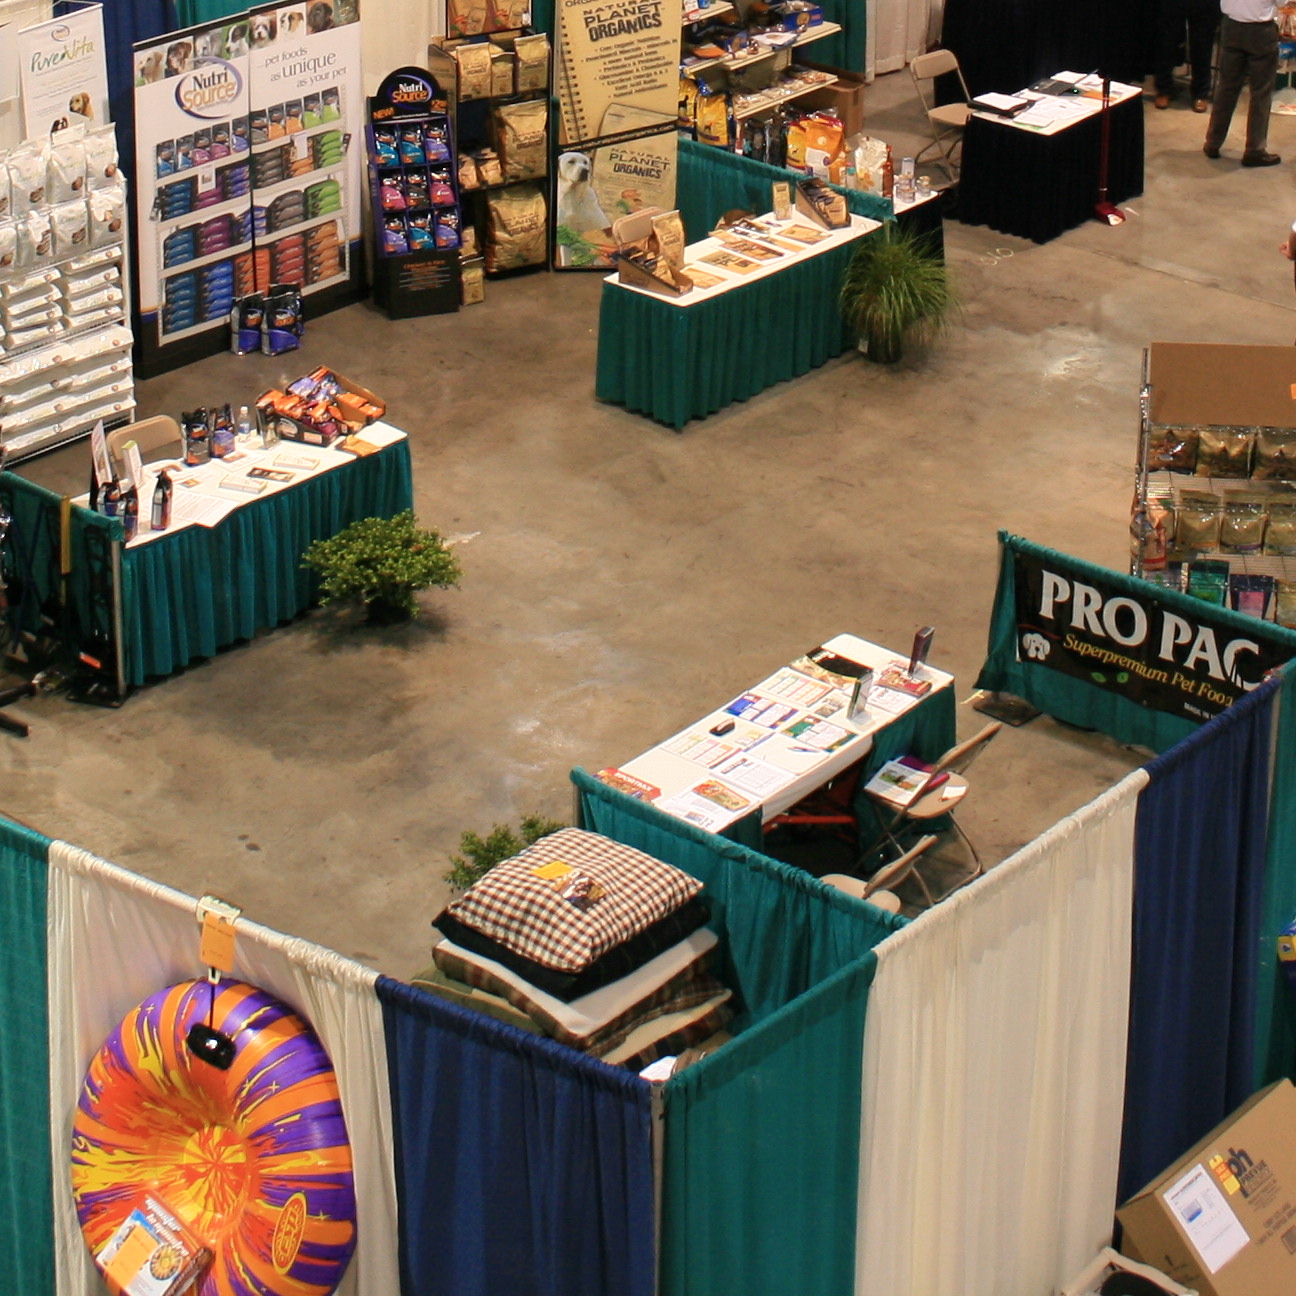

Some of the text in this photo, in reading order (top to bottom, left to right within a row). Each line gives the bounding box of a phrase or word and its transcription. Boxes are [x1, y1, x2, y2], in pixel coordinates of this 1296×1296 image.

[584, 1, 662, 28] PLANET
[589, 12, 662, 42] ORGANICS
[281, 48, 307, 61] foods
[270, 52, 337, 82] as unique
[296, 66, 347, 88] as your pet
[192, 67, 229, 91] Nutri
[398, 81, 423, 93] Nutri
[183, 82, 236, 110] Source
[392, 90, 427, 103] Source
[609, 153, 670, 171] PLANET
[611, 147, 670, 161] NATURAL
[613, 163, 662, 179] ORGANICS
[1039, 569, 1264, 692] PRO PAC
[1063, 633, 1170, 685] Superpremium
[1171, 672, 1197, 695] Pet
